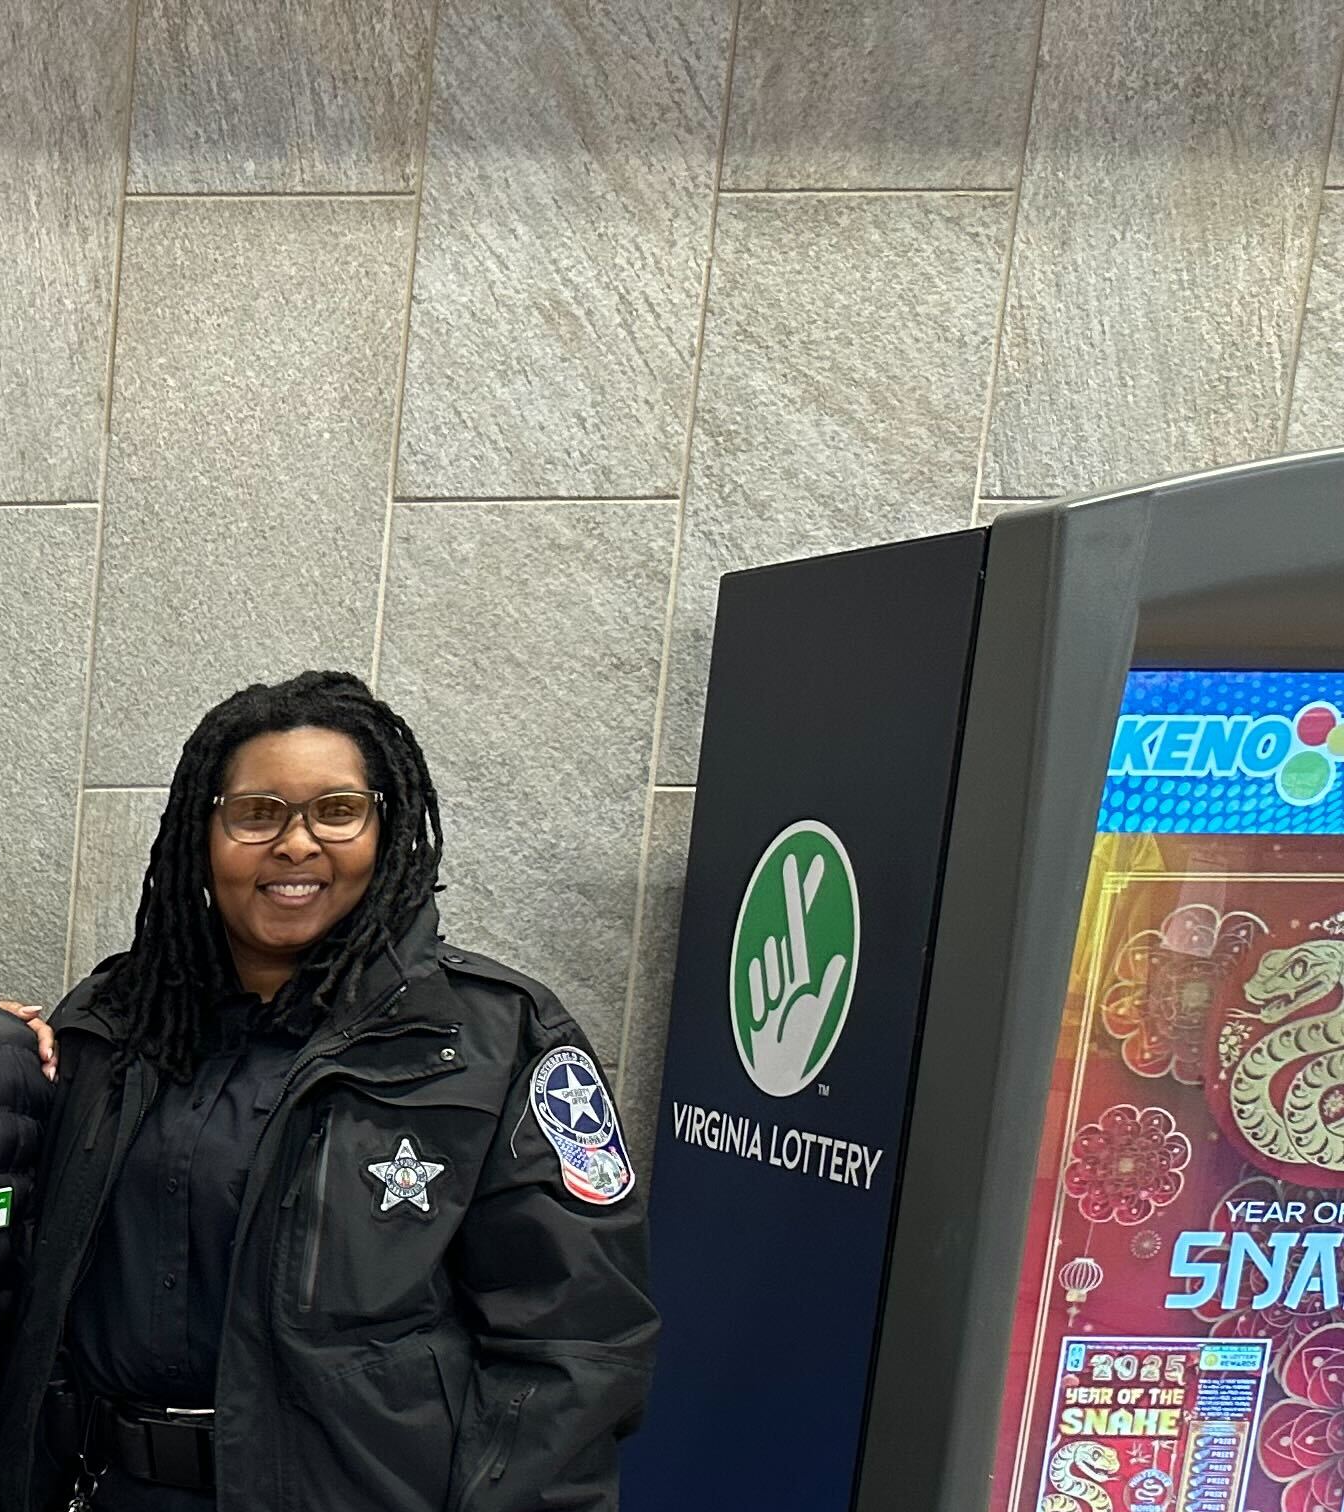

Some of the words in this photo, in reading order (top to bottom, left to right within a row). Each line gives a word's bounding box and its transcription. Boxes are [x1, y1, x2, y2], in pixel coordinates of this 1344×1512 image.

[1107, 714, 1293, 778] KENO
[672, 1101, 763, 1163] VIRGINIA
[769, 1124, 885, 1191] LOTTERY
[1225, 1201, 1307, 1224] YEAR
[1090, 1353, 1187, 1384] 2025
[1065, 1387, 1113, 1405] YEAR
[1116, 1387, 1147, 1405] OF
[1149, 1388, 1186, 1405] THE
[1059, 1407, 1182, 1437] SNAKE
